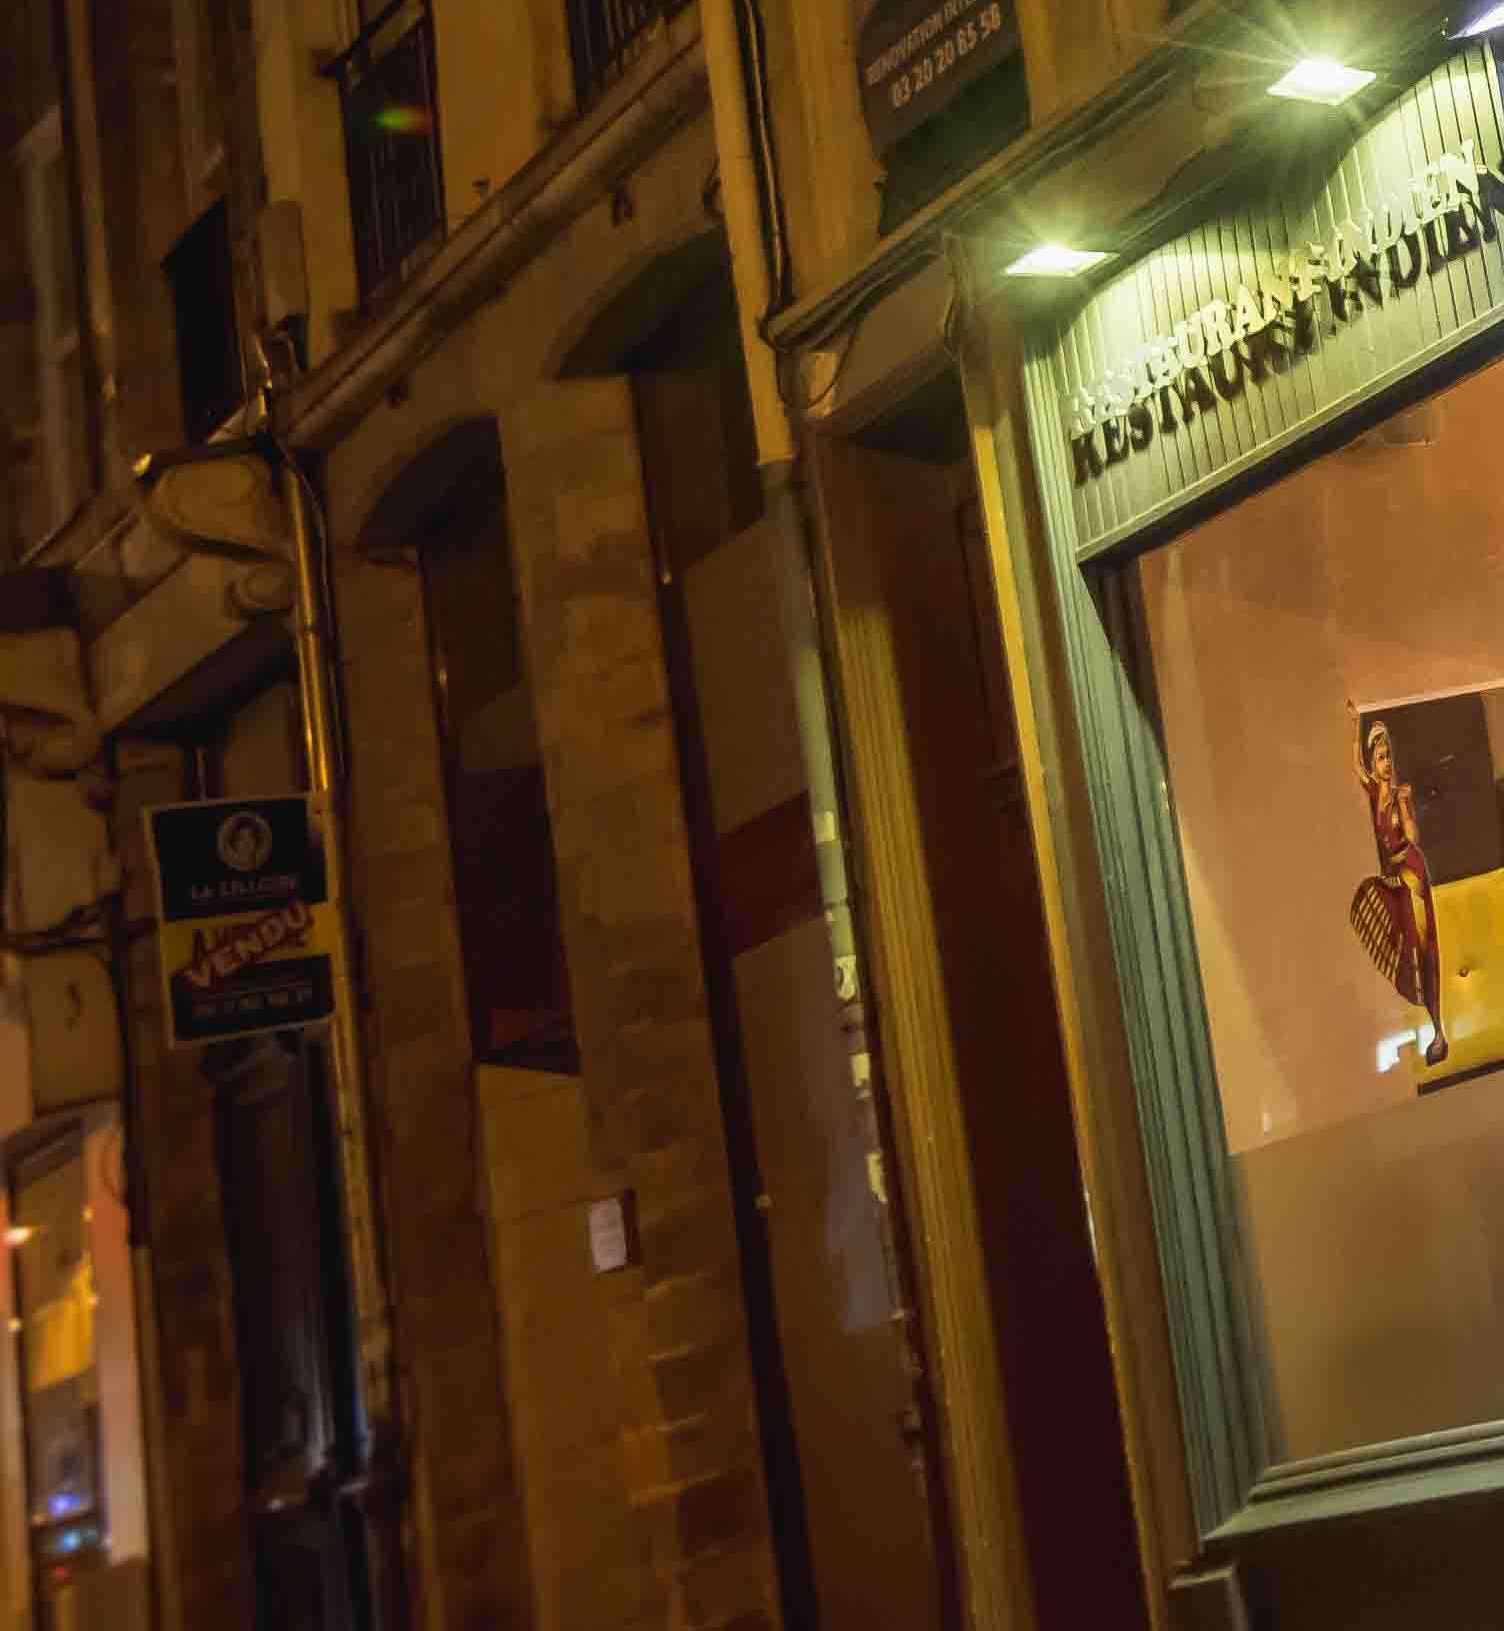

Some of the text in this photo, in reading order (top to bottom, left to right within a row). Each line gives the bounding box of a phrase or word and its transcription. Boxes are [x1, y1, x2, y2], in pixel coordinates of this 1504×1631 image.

[1069, 137, 1487, 441] RESTAURANT INDIEN
[184, 901, 311, 988] VENDU
